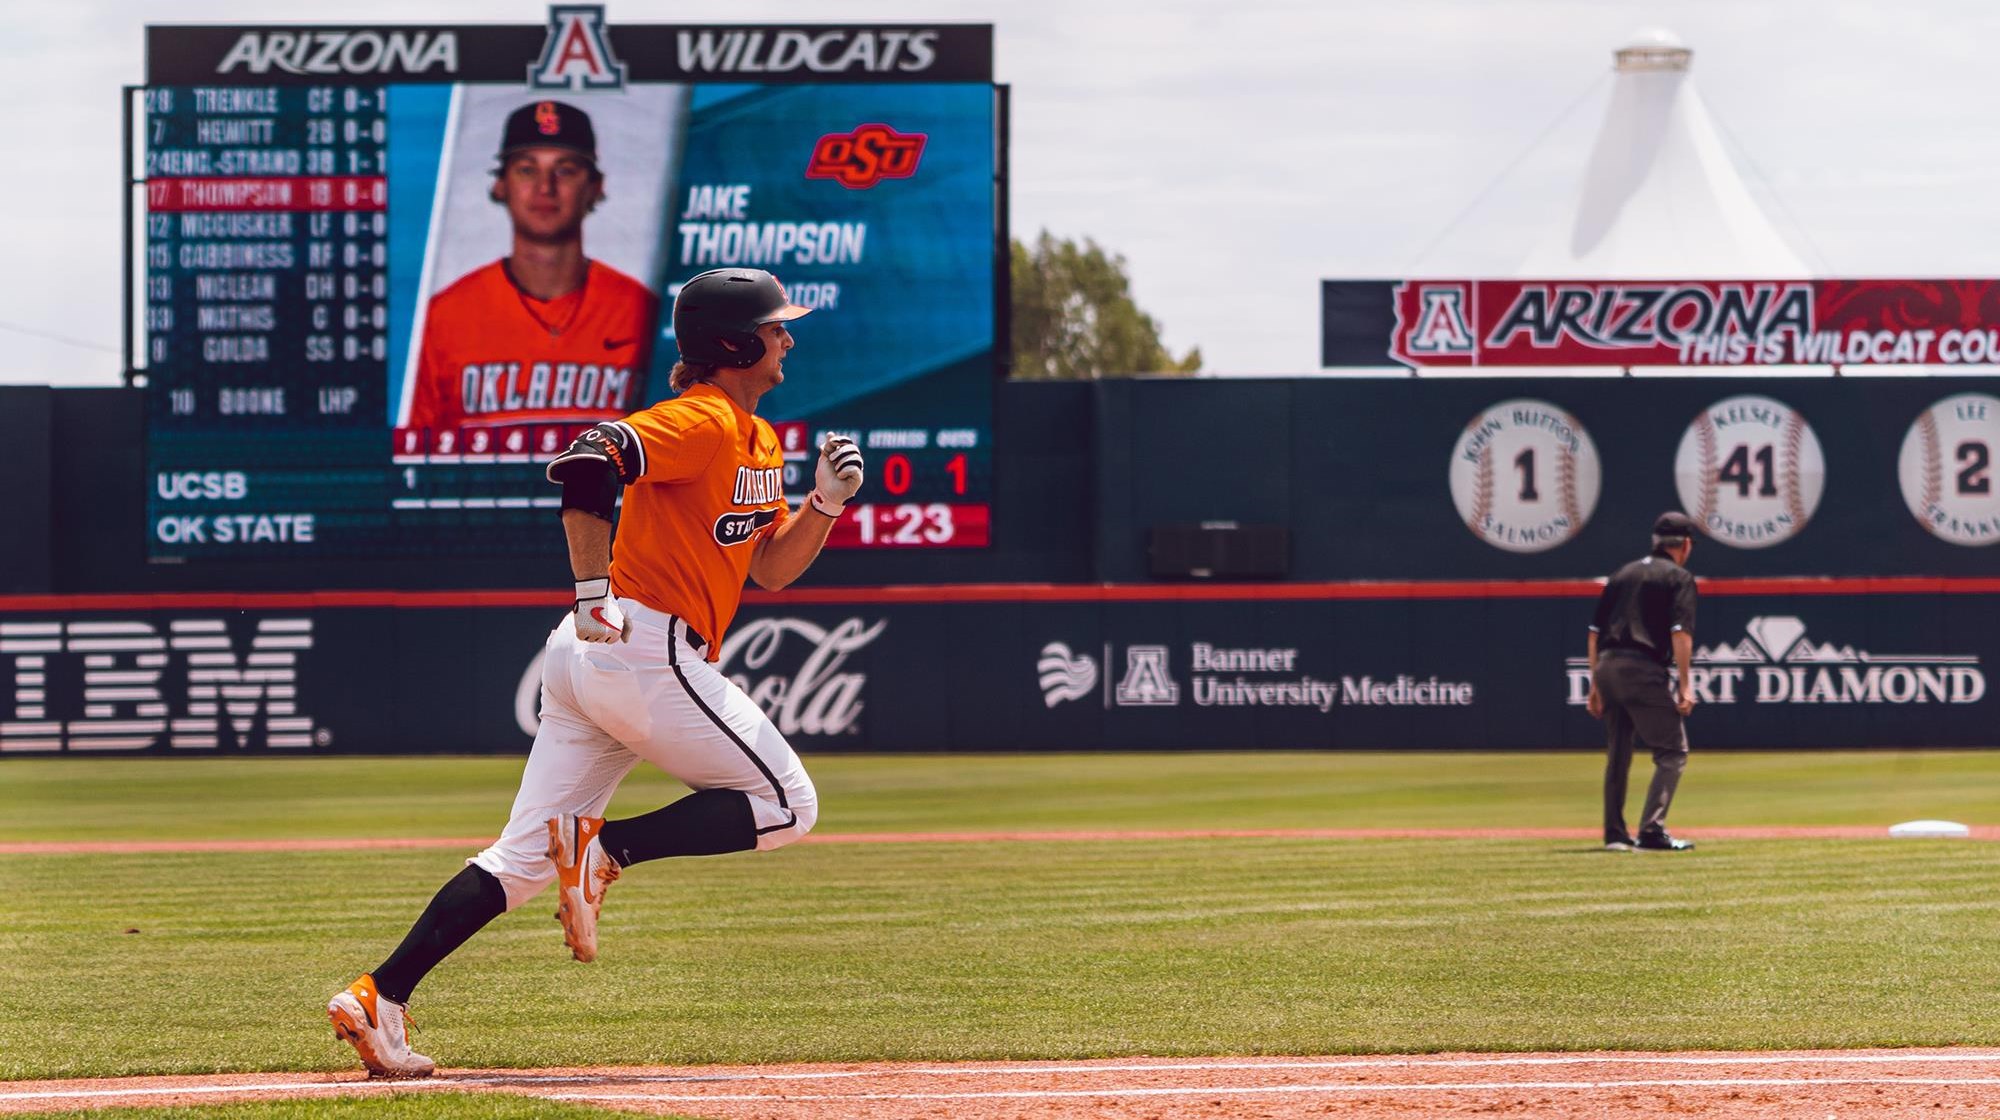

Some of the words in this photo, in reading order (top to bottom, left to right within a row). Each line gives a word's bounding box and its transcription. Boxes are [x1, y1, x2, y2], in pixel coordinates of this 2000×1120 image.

[217, 31, 458, 75] ARIZONA
[676, 30, 939, 72] WILDCATS
[194, 88, 278, 113] TRENKLE
[308, 88, 333, 113] CF
[805, 123, 928, 190] OSU
[182, 182, 292, 206] THOMPSON
[683, 185, 750, 219] JAKE
[310, 212, 331, 236] LF
[679, 222, 866, 265] THOMPSON
[1484, 284, 1814, 350] ARIZONA
[1678, 331, 1748, 364] THIS
[1753, 331, 1785, 364] IS
[1790, 329, 1935, 363] WILDCAT
[1956, 403, 1986, 421] LEE
[1463, 418, 1503, 465] JOHN
[157, 472, 247, 500] UCSB
[884, 453, 912, 496] 0
[945, 453, 968, 496] 1
[1513, 447, 1540, 503] 1
[1716, 442, 1779, 498] 41
[1955, 440, 1992, 496] 2
[156, 516, 205, 543] OK
[213, 515, 314, 543] STATE
[853, 502, 955, 545] 1:23
[1480, 512, 1572, 543] SALMON
[1706, 511, 1793, 540] OSBURN
[1192, 642, 1297, 671] Banner
[0, 619, 313, 749] IBM
[1192, 677, 1337, 712] University
[1342, 675, 1473, 706] Medicine
[1565, 668, 1744, 704] DRT
[1754, 666, 1986, 704] DIAMOND
